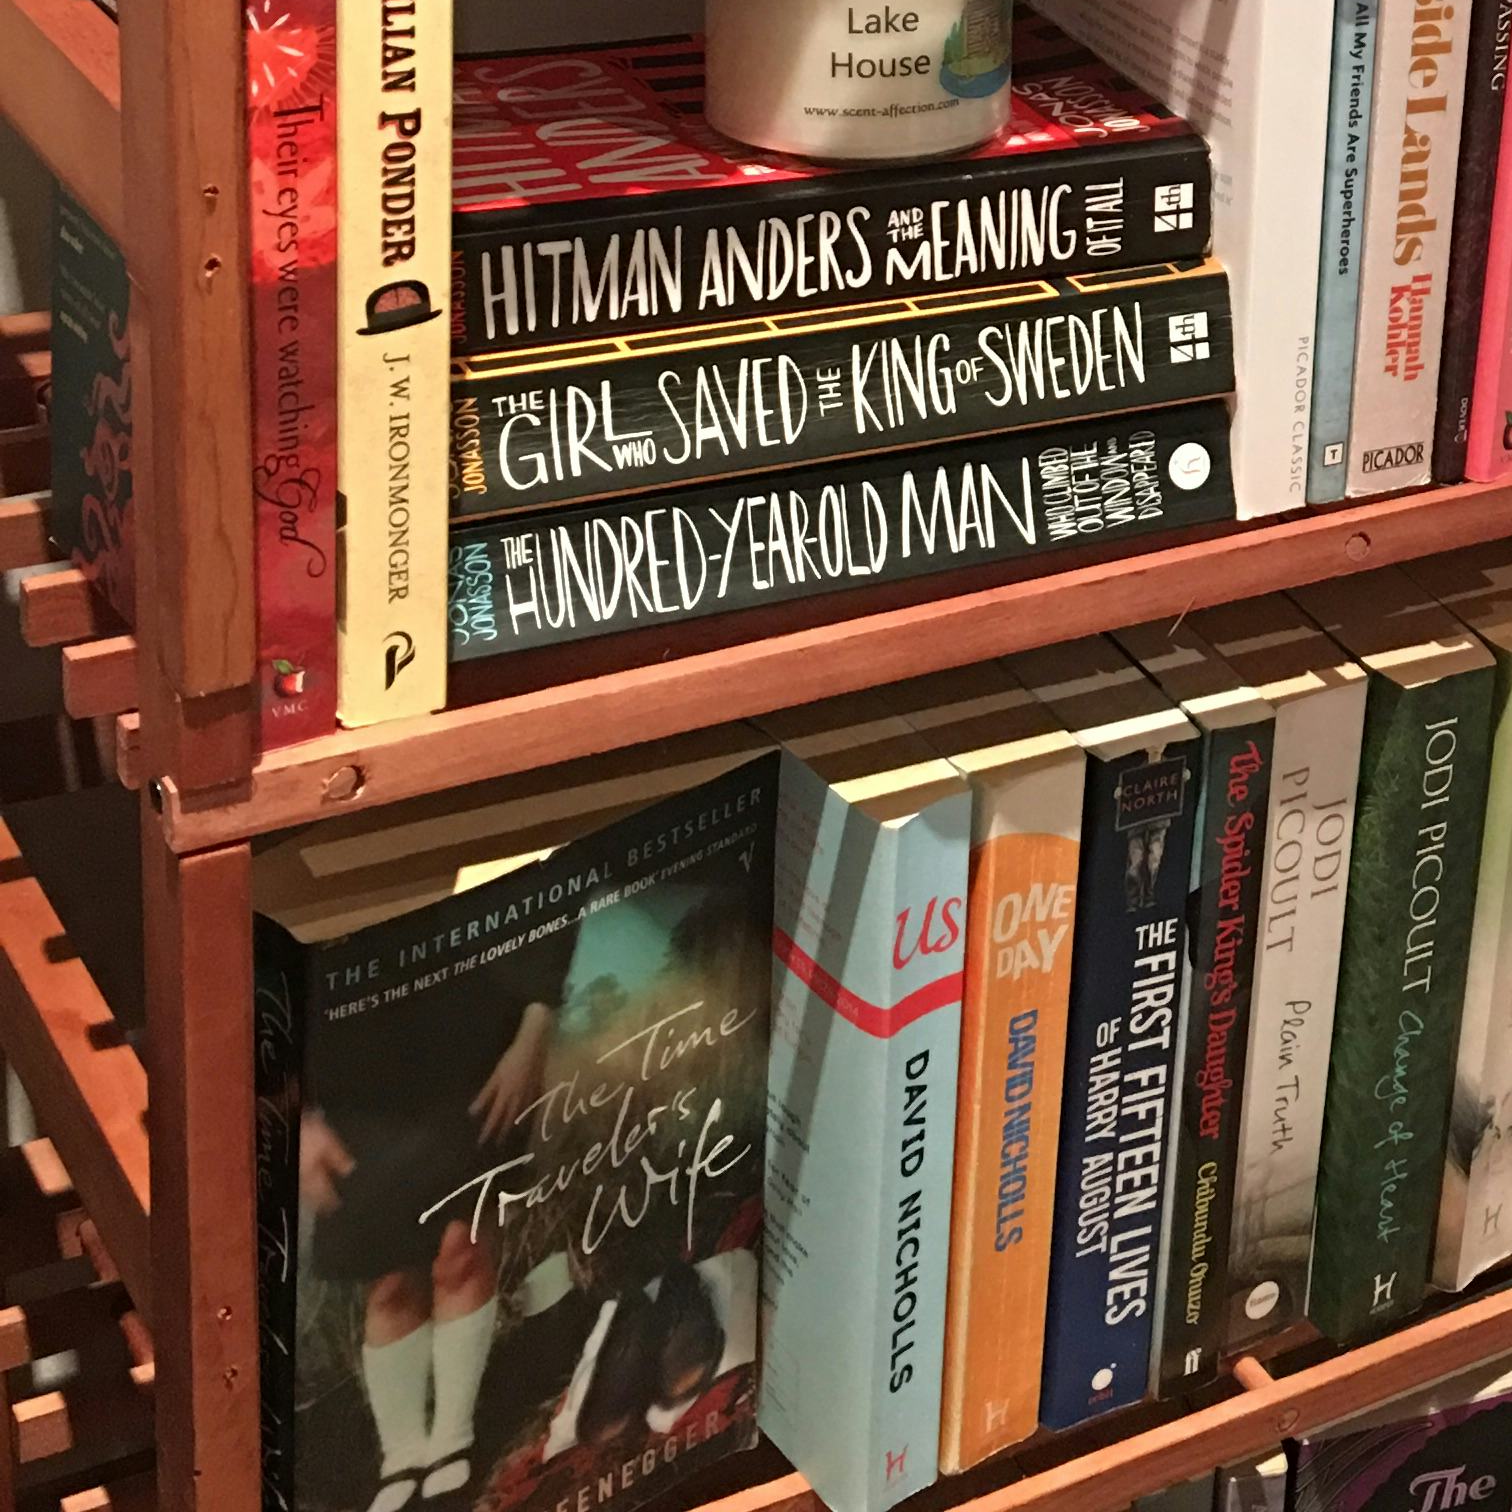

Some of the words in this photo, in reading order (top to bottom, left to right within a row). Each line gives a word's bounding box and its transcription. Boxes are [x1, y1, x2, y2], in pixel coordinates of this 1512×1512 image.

[848, 6, 919, 34] Lake
[1352, 33, 1366, 58] My
[1355, 2, 1370, 27] All
[831, 52, 931, 78] House
[1346, 64, 1365, 128] Friends
[378, 108, 423, 268] PONDER
[1346, 133, 1358, 163] Are
[1337, 168, 1358, 276] Superheroes
[817, 367, 843, 417] THE
[851, 332, 956, 434] KING
[956, 357, 984, 385] OF
[978, 301, 1146, 407] SWEDEN
[491, 390, 545, 417] THE
[499, 380, 653, 490] GIRL
[658, 355, 808, 466] SAVED
[613, 439, 656, 469] WHO
[1120, 789, 1178, 813] NORTH
[1123, 774, 1179, 798] CLAIRE
[1421, 717, 1459, 811] JODI
[325, 959, 381, 991] THE
[399, 864, 614, 967] INTERNATIONAL
[626, 788, 763, 867] BESTSELLER
[1135, 919, 1179, 951] THE
[1402, 819, 1448, 993] PICOULT
[1096, 1018, 1121, 1048] OF
[1128, 951, 1177, 1053] FIRST
[900, 1050, 930, 1178] DAVID
[1084, 1049, 1123, 1143] HARRY
[1115, 1064, 1168, 1221] FIFTEEN
[1075, 1157, 1115, 1259] AUGUST
[889, 1190, 923, 1394] NICHOLLS
[1104, 1228, 1152, 1327] LIVES
